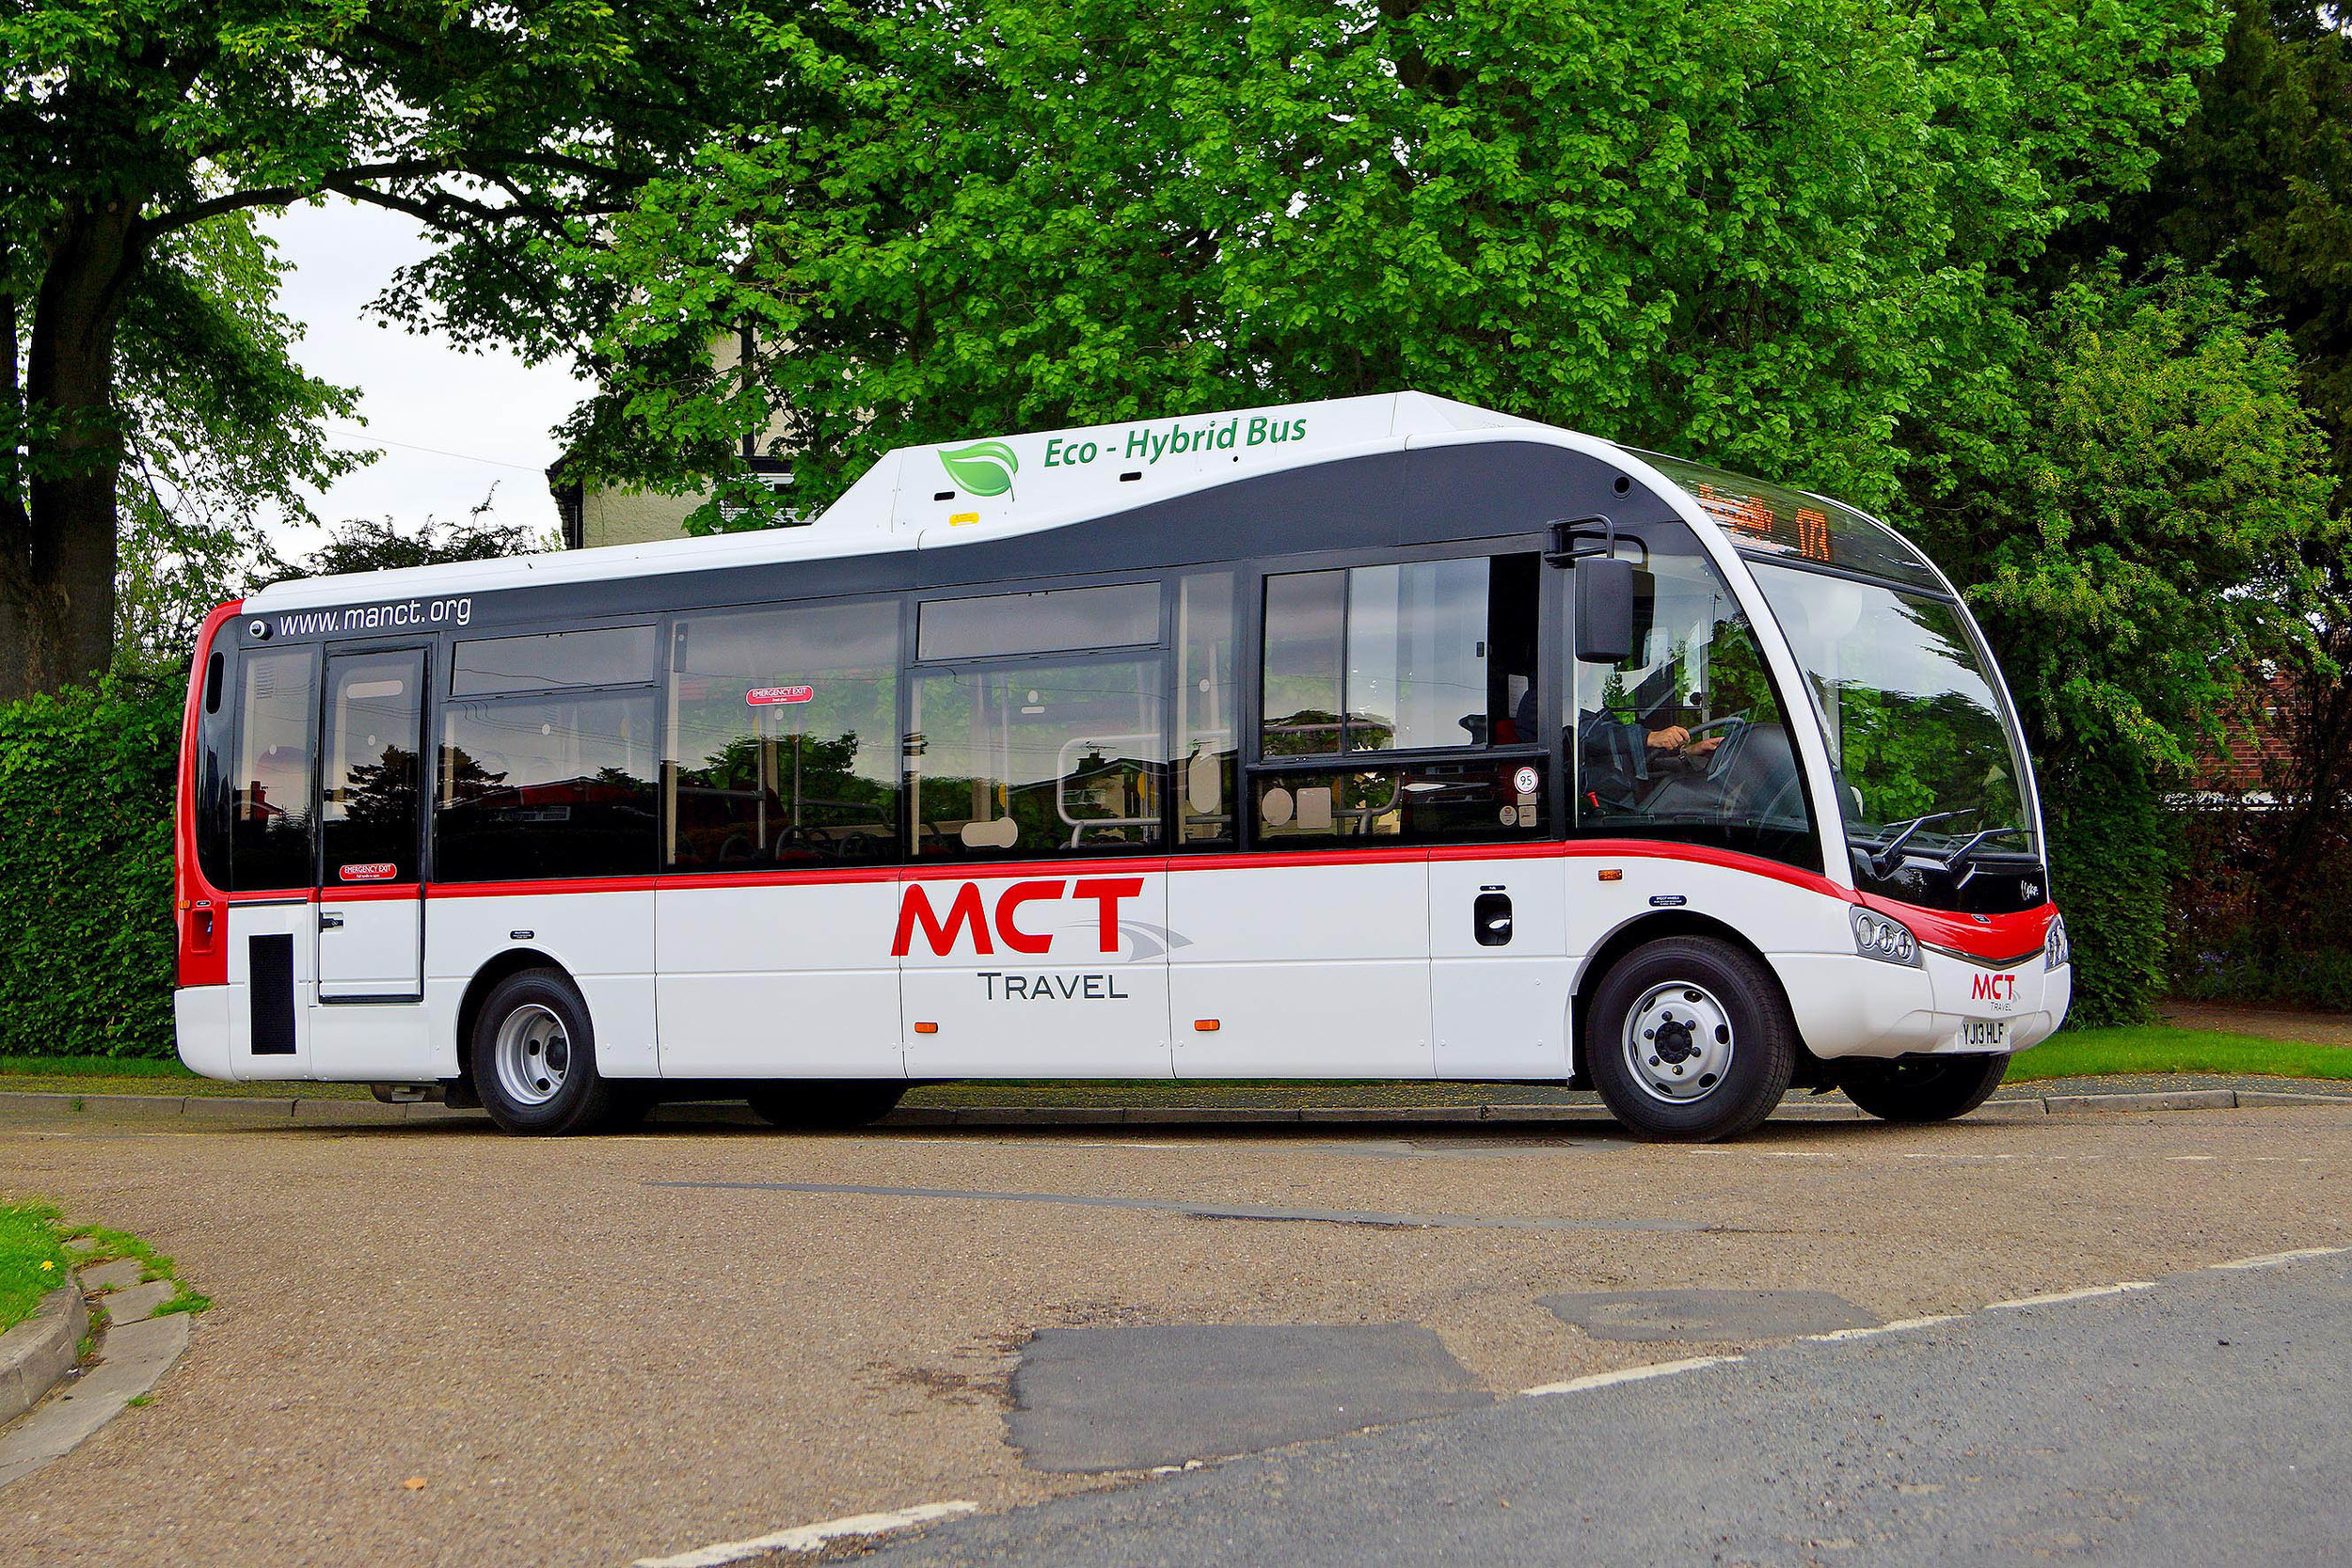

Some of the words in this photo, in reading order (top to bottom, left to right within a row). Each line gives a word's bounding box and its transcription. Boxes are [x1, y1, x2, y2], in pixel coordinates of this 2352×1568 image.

[1043, 437, 1098, 467] Eco
[1125, 417, 1239, 466] Hybrid
[1246, 417, 1307, 447] Bus
[279, 596, 472, 636] www.manct.org
[753, 688, 791, 697] EMERGENCY
[792, 687, 807, 695] EXIT
[1519, 774, 1533, 786] 95
[344, 865, 377, 874] EMERGENCY
[378, 864, 391, 873] EXIT
[890, 878, 1145, 958] MCT
[977, 973, 1129, 1001] TRAVEL
[1971, 973, 2015, 1001] MCT
[1990, 1001, 2012, 1012] TRAVEL
[1963, 1023, 1984, 1045] YJ13
[1986, 1022, 2004, 1044] HLF
